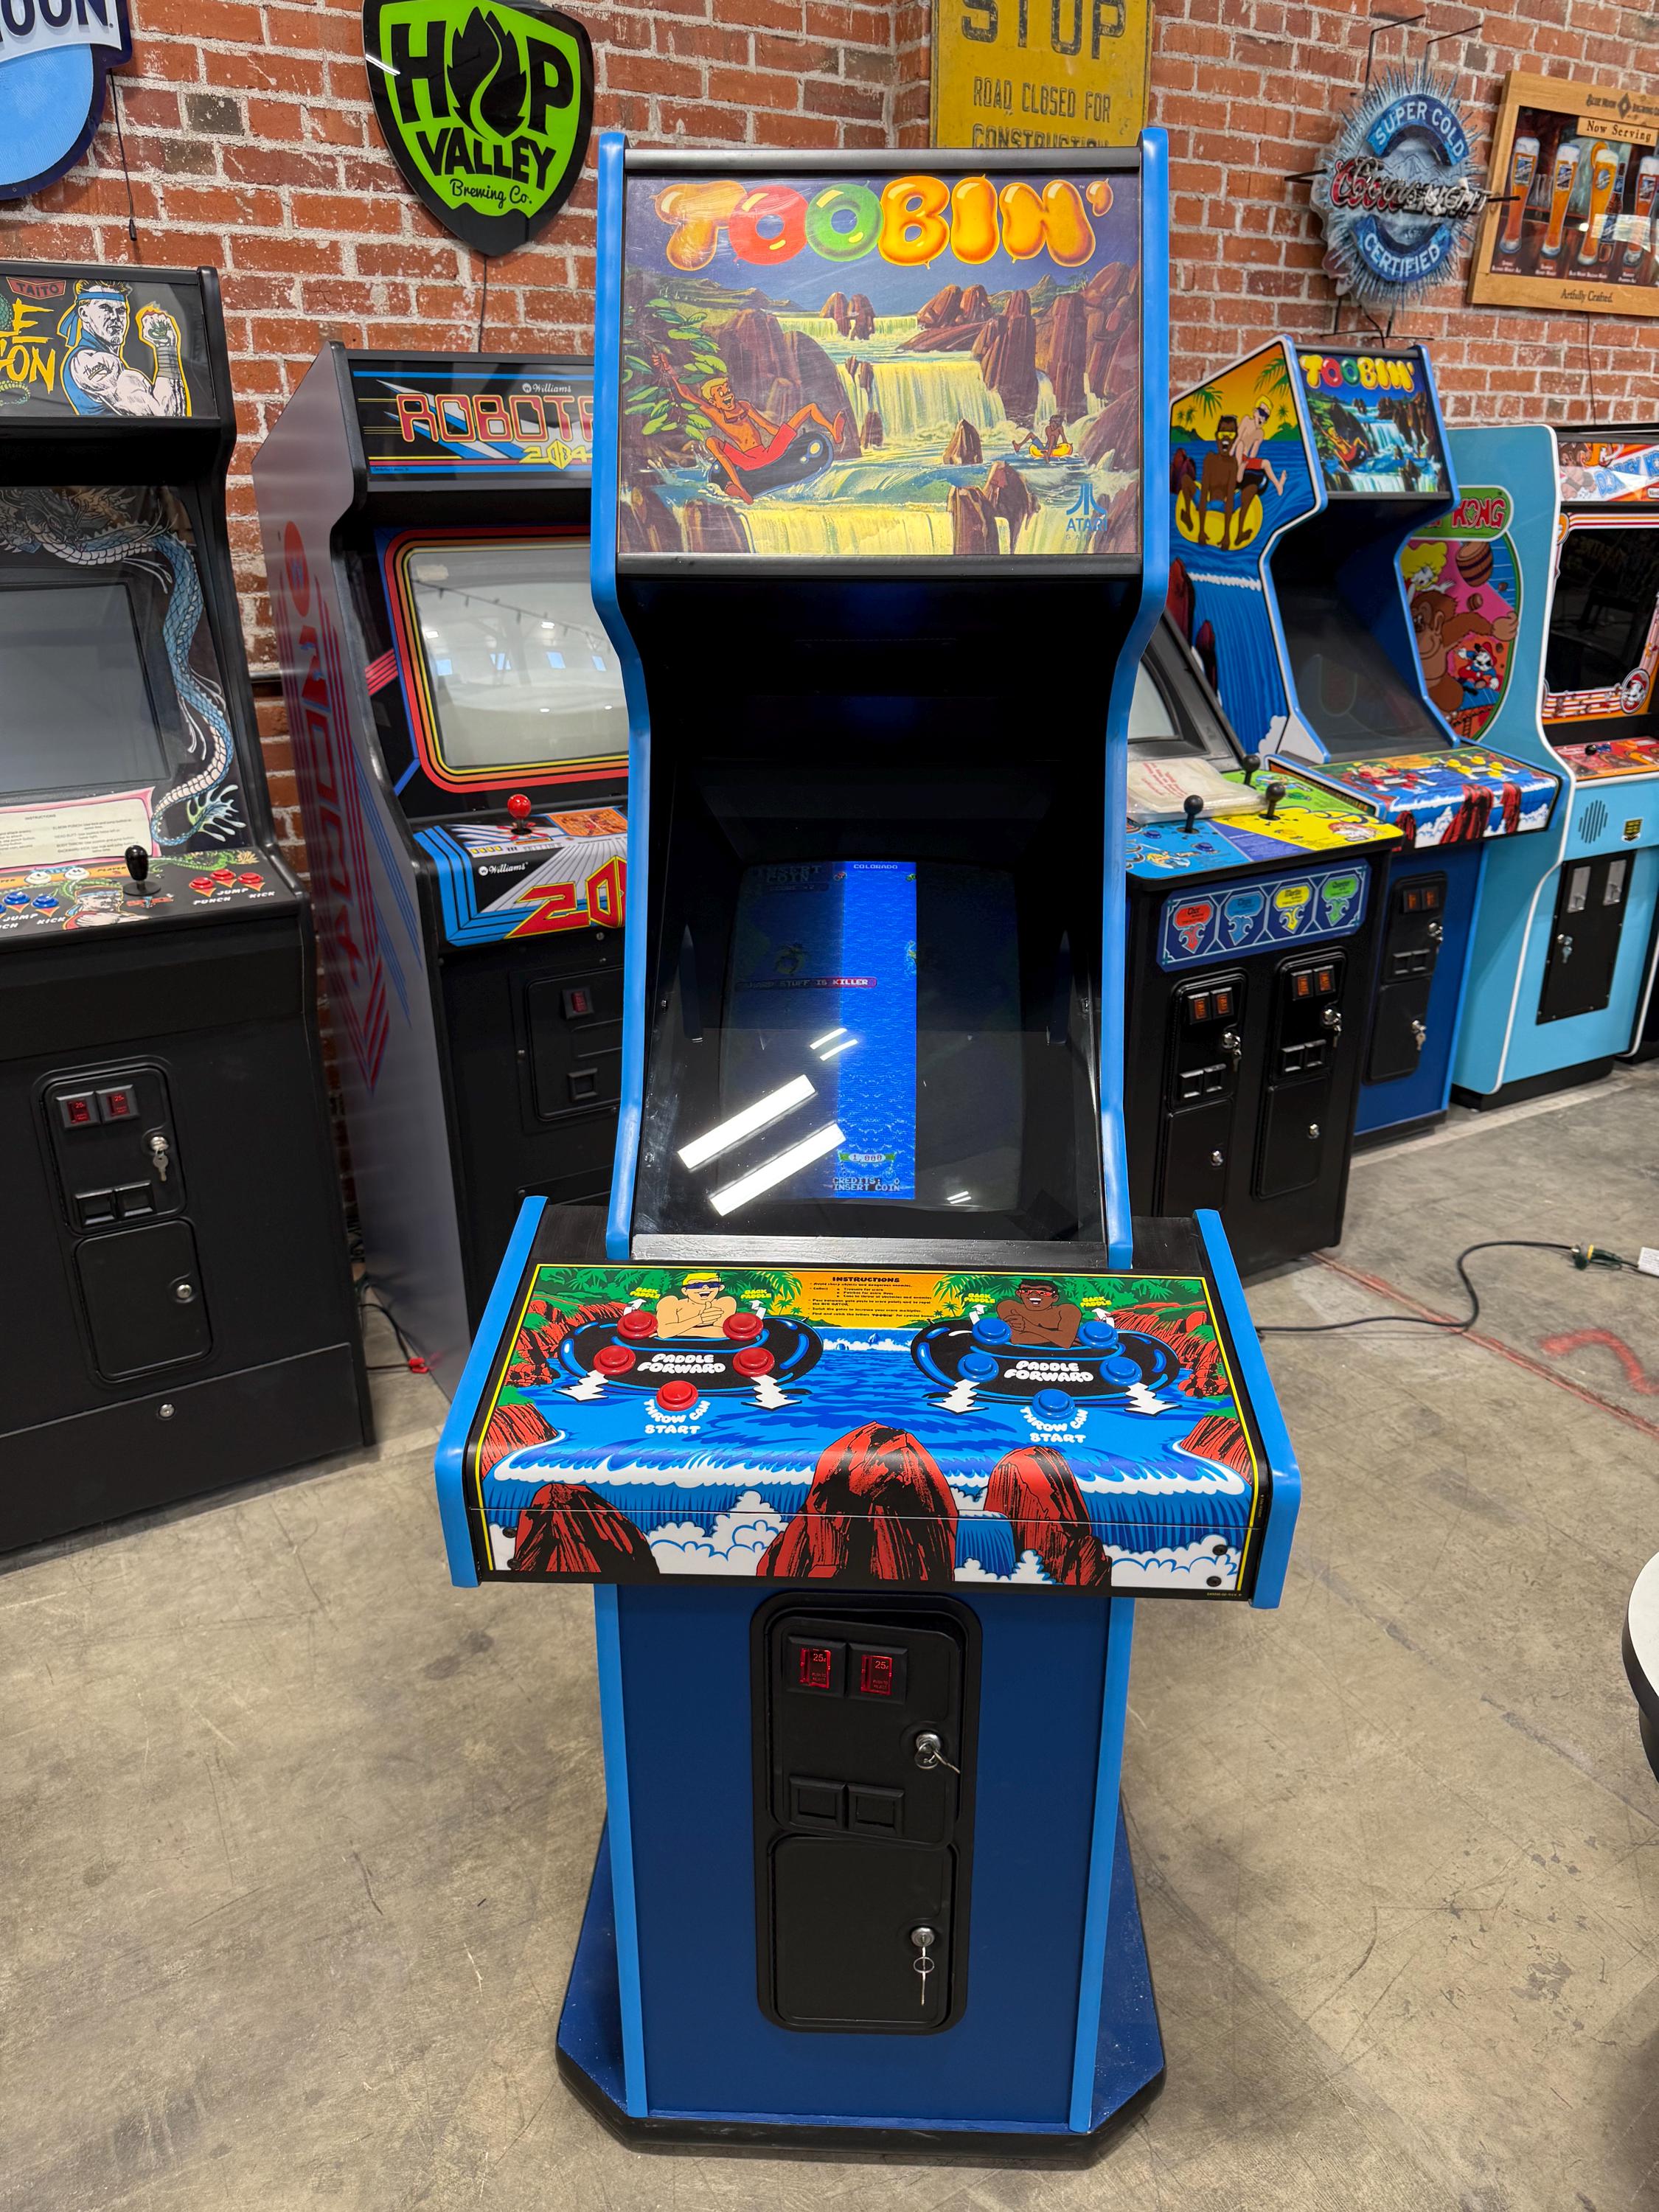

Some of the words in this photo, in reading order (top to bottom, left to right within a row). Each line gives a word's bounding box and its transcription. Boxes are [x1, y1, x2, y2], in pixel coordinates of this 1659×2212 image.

[973, 77, 1012, 110] ROAD
[1022, 82, 1076, 118] CLOSED
[1085, 91, 1110, 123] FOR
[1375, 101, 1427, 146] SUPER
[1432, 108, 1465, 157] COLD
[1587, 120, 1607, 133] Now
[1613, 125, 1652, 142] Serving
[416, 127, 556, 190] VALLEY
[450, 178, 507, 208] Brewing
[509, 185, 532, 204] Co.
[652, 175, 1114, 271] TOOBIN'
[1364, 232, 1441, 277] CERTIFIED
[16, 282, 60, 296] TAITO
[1561, 288, 1586, 304] Artfully
[1587, 291, 1613, 303] Crafted.
[1298, 354, 1415, 393] TOOBIN'
[532, 383, 572, 393] Williams
[1451, 497, 1506, 529] KONG
[1066, 518, 1107, 532] ATARI
[488, 863, 526, 874] Williams
[216, 888, 249, 896] JUMP
[193, 897, 232, 905] PUNCH
[3, 914, 38, 922] JUMP
[37, 917, 66, 925] KICK
[832, 1177, 881, 1185] CREDITS:
[652, 1353, 714, 1364] PADDLE
[637, 1362, 726, 1374] FORWARD
[1016, 1360, 1079, 1372] PADDLE
[1004, 1368, 1094, 1382] FORWARD
[644, 1399, 686, 1424] THROW
[689, 1400, 711, 1421] CAN
[1020, 1405, 1068, 1432] THROW
[1070, 1409, 1088, 1429] CAN
[644, 1424, 701, 1434] START
[1029, 1432, 1086, 1444] START
